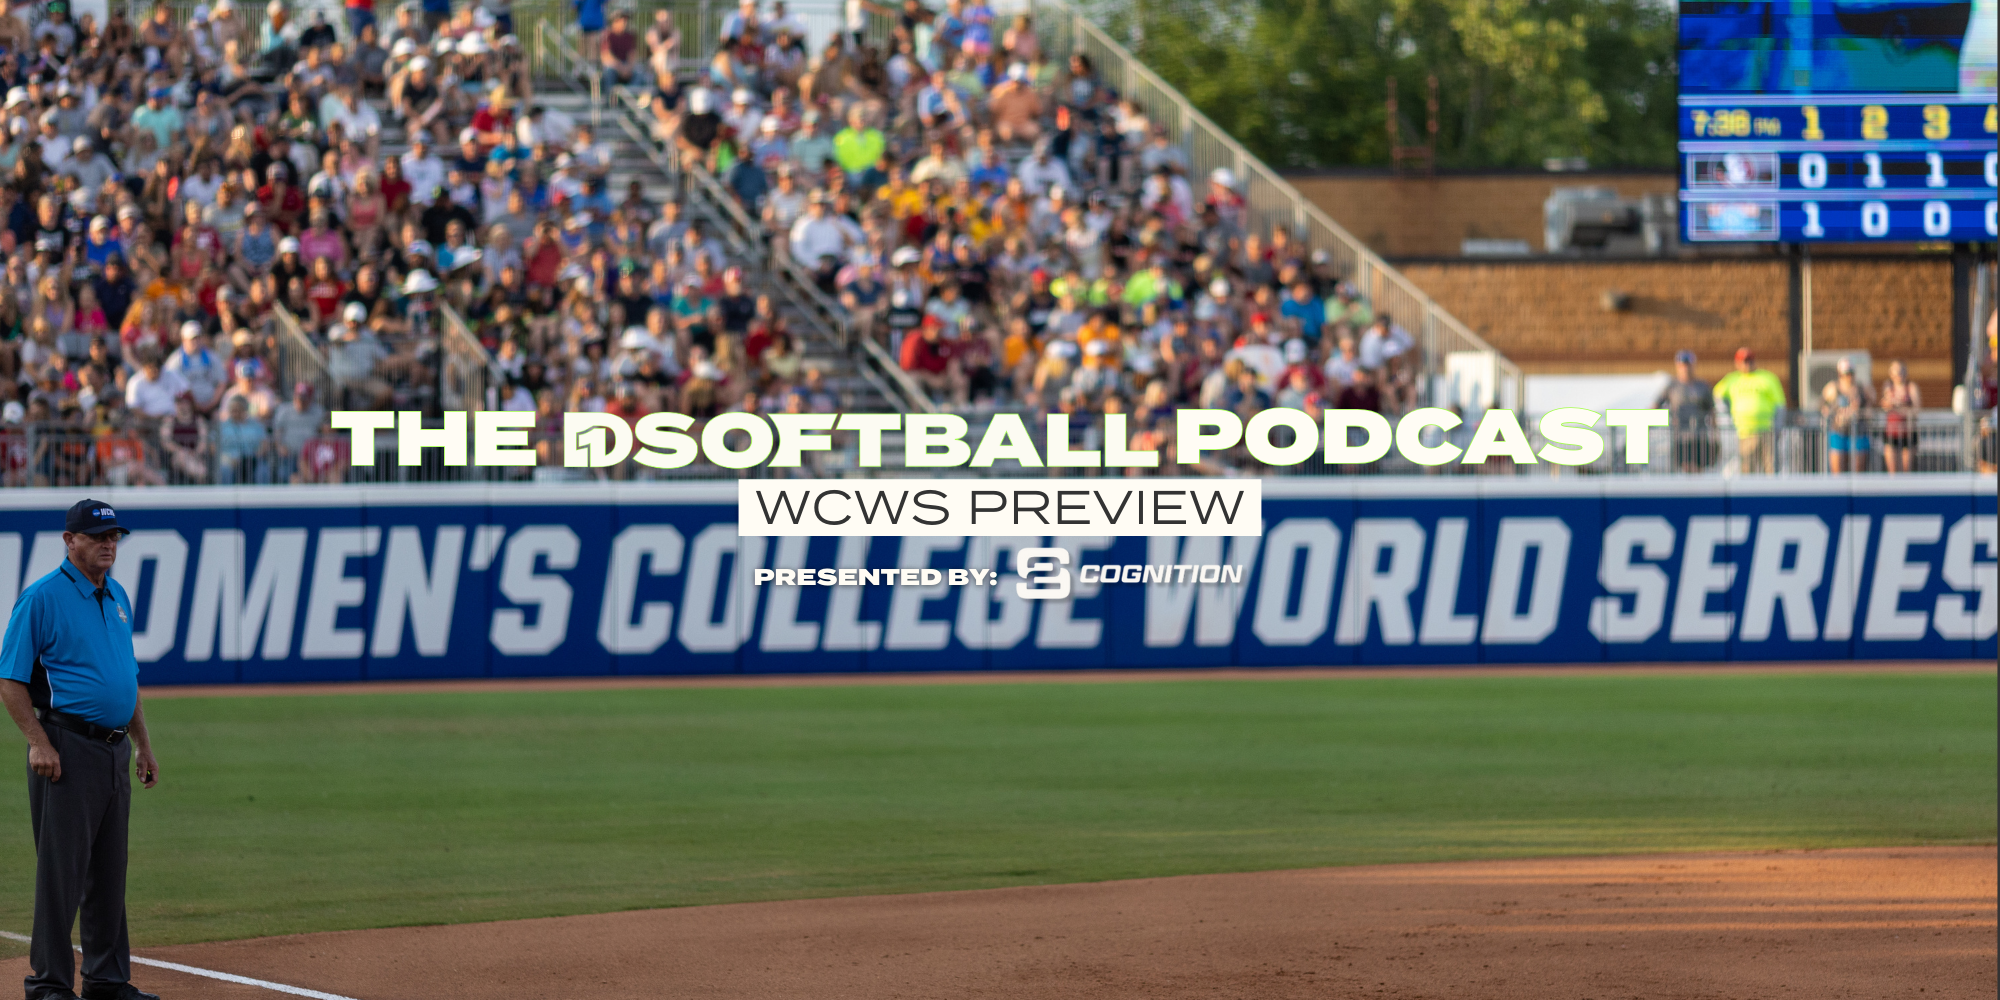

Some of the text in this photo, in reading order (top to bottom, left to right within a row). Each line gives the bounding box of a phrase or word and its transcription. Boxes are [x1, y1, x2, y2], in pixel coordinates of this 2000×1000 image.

[1800, 105, 1824, 140] 1
[1861, 104, 1889, 140] 2
[1922, 104, 1950, 140] 3
[1798, 152, 1828, 189] 0
[1863, 152, 1886, 188] 1
[1925, 152, 1948, 188] 1
[1802, 200, 1825, 238] 1
[1860, 200, 1889, 238] 0
[1922, 200, 1951, 237] 0
[597, 525, 1120, 654] COLLEGE
[1143, 516, 1572, 647] WORLD
[1587, 514, 1997, 644] SERIES
